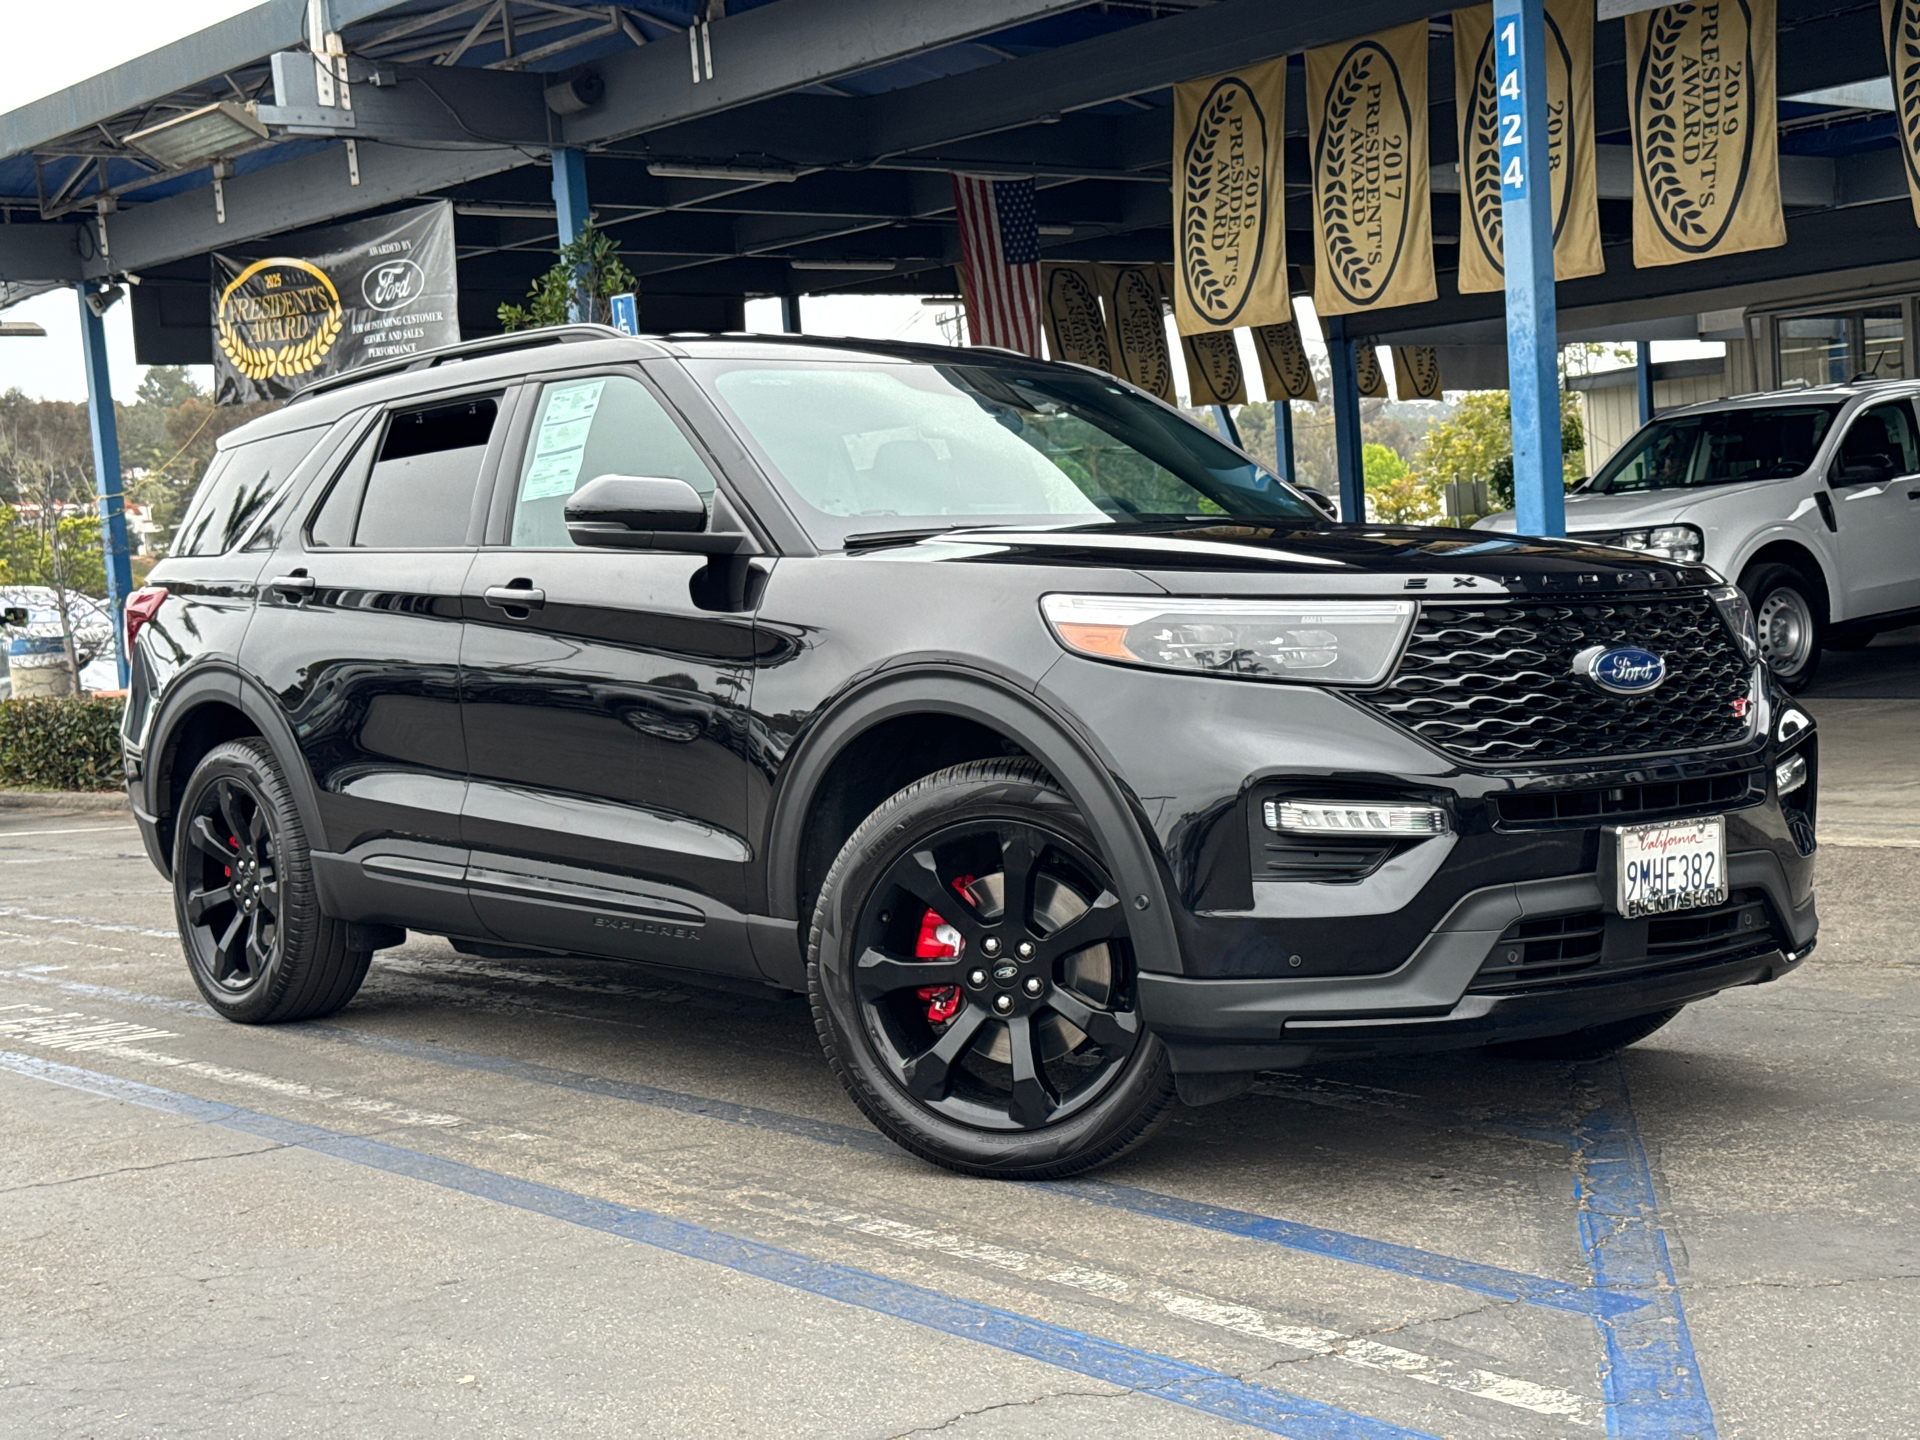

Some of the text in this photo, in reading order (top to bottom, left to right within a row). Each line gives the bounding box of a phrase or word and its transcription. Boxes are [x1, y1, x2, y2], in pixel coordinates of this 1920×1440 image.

[1500, 21, 1524, 189] 1424
[1681, 54, 1702, 166] AWARD
[1698, 2, 1721, 208] PRESIDENT'S
[1722, 60, 1742, 136] 2019
[1546, 100, 1565, 172] 2018
[1350, 127, 1367, 228] AWARD
[1366, 82, 1383, 266] PRESIDENT'S
[1383, 134, 1403, 201] 2017
[1211, 160, 1231, 251] AWARD
[1223, 115, 1244, 289] PRESIDENT'S
[1243, 165, 1261, 230] 2016
[368, 240, 413, 257] AWARDED BY
[229, 285, 330, 323] PRESIDENT'S
[375, 266, 412, 304] Ford
[248, 314, 309, 344] AWARD
[388, 330, 402, 342] AND
[403, 327, 424, 339] SALES
[402, 311, 444, 326] CUSTOMER
[1058, 318, 1077, 351] 2021
[1122, 319, 1138, 354] 2020
[367, 343, 417, 358] PERFORMANCE
[1613, 656, 1655, 681] Ford
[1640, 828, 1704, 854] California
[1627, 851, 1715, 900] 9MHE382
[1693, 888, 1724, 907] FORD
[594, 918, 701, 941] EXPLORER
